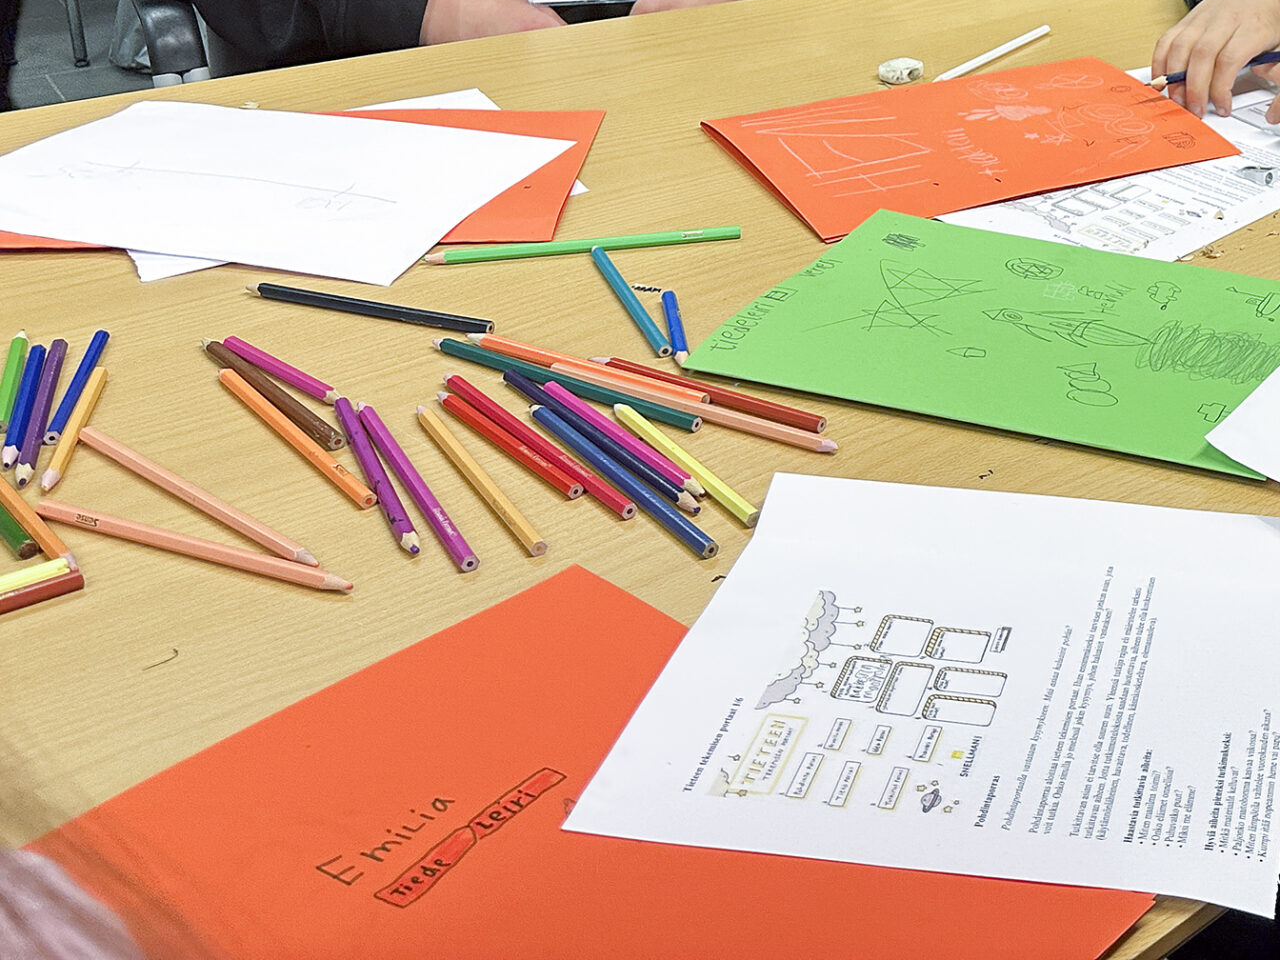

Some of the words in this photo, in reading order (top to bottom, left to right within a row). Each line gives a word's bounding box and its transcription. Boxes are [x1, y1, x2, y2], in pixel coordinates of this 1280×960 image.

[75, 512, 99, 528] Sense
[682, 767, 703, 791] Tieteen
[699, 733, 722, 765] tekemisen
[719, 708, 737, 732] portaat
[741, 720, 784, 784] TIETEEN
[959, 738, 979, 776] SNELLMAN
[1257, 732, 1268, 771] vuorokauden
[974, 775, 999, 827] Pohdintaporras
[1001, 774, 1027, 830] Pohdintaportaalla
[1028, 786, 1050, 833] Pohdintaporras
[1044, 762, 1057, 785] aloittaa
[1051, 740, 1064, 761] tieteen
[1123, 810, 1138, 842] Haastavia
[1132, 775, 1146, 808] tutkittavia
[1140, 749, 1152, 772] aiheita:
[1183, 785, 1195, 812] elämme?
[1212, 779, 1224, 806] pieneksi
[1252, 773, 1263, 799] vaihtelee
[1257, 833, 1270, 857] Kumpi
[1270, 751, 1278, 760] vai
[1042, 821, 1053, 834] voit
[1051, 780, 1065, 799] Onko
[1069, 800, 1087, 836] Tutkittavan
[1084, 804, 1099, 838] tutkittavan
[1137, 820, 1150, 839] Miten
[1144, 793, 1156, 819] maailma
[1155, 799, 1167, 821] eläimet
[1164, 808, 1179, 842] Puhuvatko
[1173, 789, 1182, 808] puut?
[1183, 813, 1191, 824] me
[1208, 807, 1219, 828] aiheita
[1218, 827, 1230, 848] Mitkä
[1226, 765, 1238, 793] kelluvat?
[1231, 821, 1245, 851] Paljonko
[1242, 759, 1253, 779] kasvaa
[1247, 801, 1260, 832] lämpötila
[1150, 822, 1163, 841] Onko
[1176, 825, 1189, 843] Miksi
[1204, 830, 1216, 850] Hyviä
[1244, 833, 1256, 854] Miten
